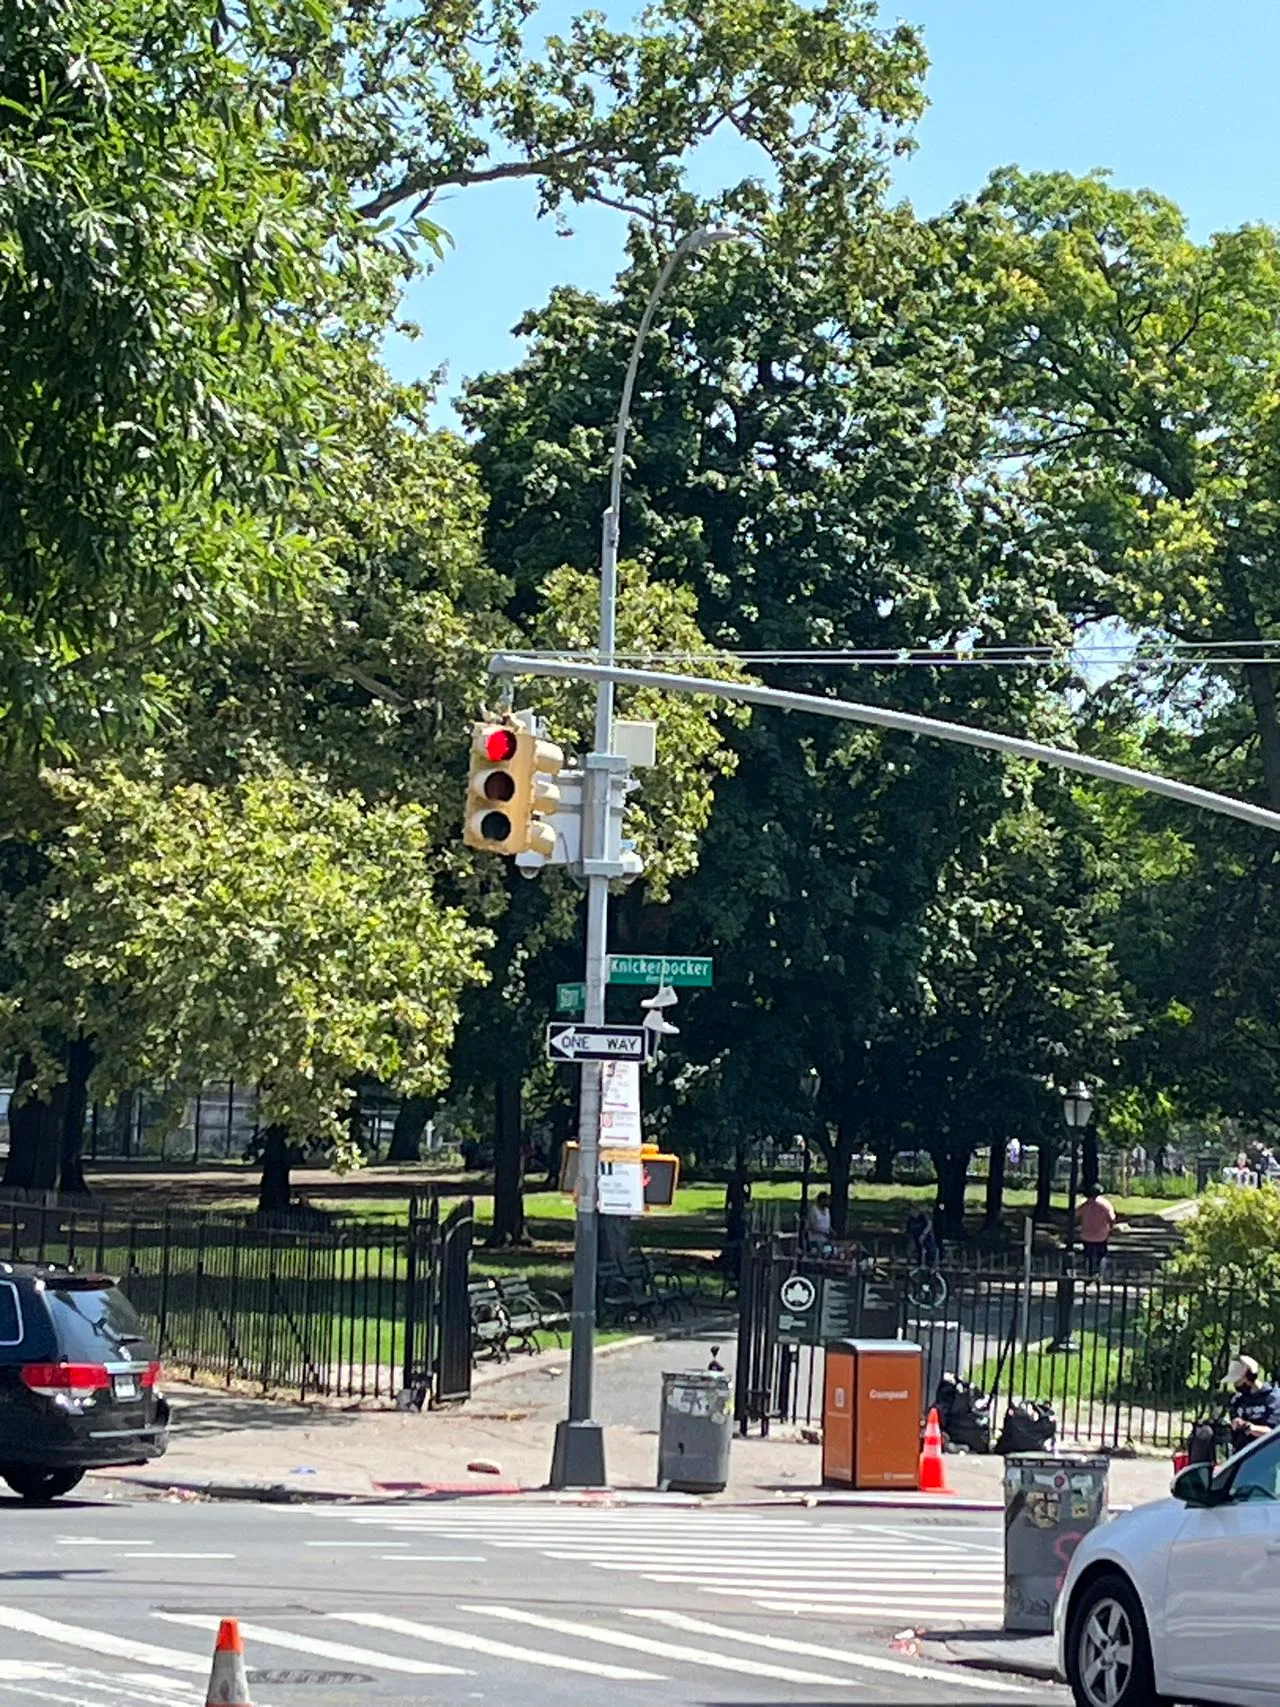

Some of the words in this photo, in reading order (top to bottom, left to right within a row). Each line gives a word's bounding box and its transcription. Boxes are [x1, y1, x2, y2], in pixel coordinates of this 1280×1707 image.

[611, 959, 709, 976] Knickerbocker
[561, 1035, 590, 1049] ONE
[606, 1037, 638, 1051] WAY
